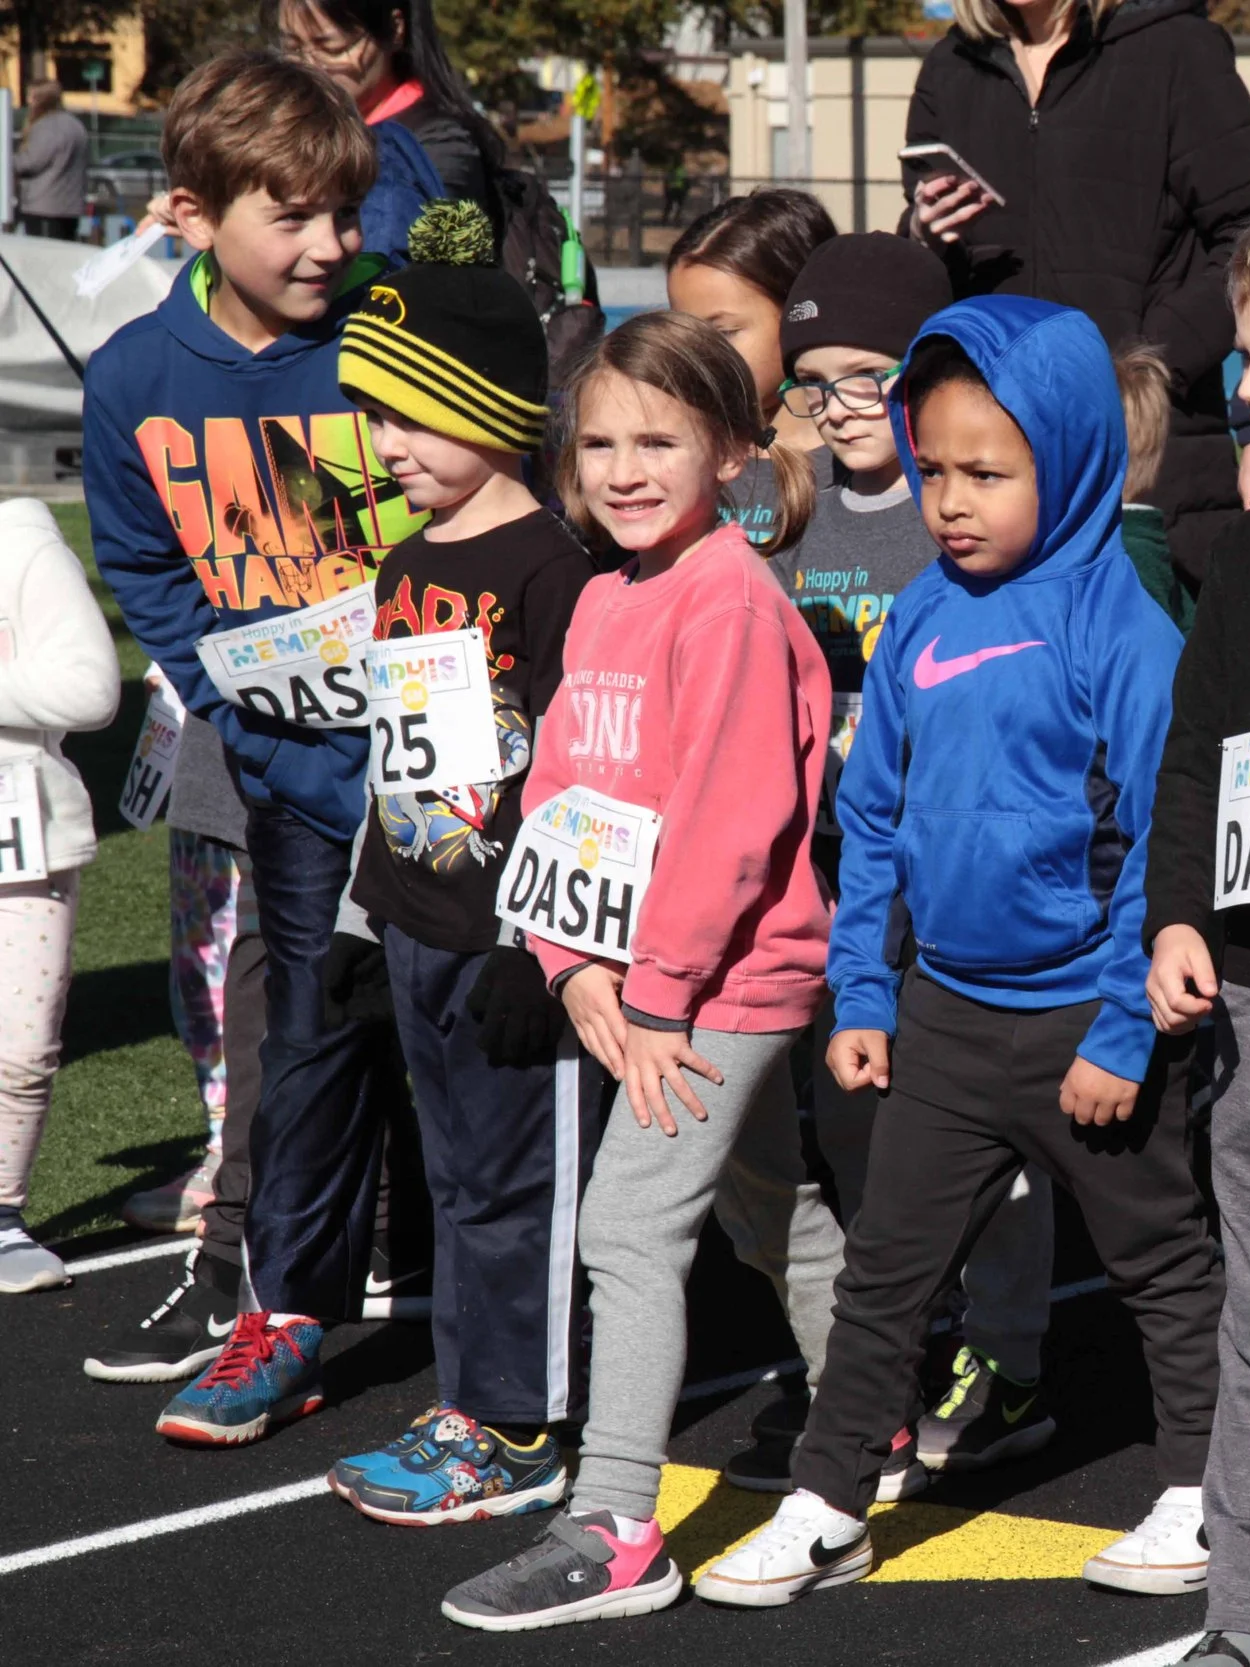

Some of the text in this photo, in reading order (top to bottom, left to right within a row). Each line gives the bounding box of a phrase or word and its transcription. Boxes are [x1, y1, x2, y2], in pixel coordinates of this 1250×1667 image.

[753, 504, 772, 524] in
[805, 566, 868, 592] Happy in
[227, 608, 369, 668] MEMPHIS
[241, 616, 303, 640] Happy in
[236, 658, 369, 725] DAS
[367, 655, 457, 691] MPHIS
[375, 713, 437, 783] 25
[124, 756, 163, 819] SH
[540, 801, 631, 854] MEMPHIS
[506, 846, 635, 951] DASH
